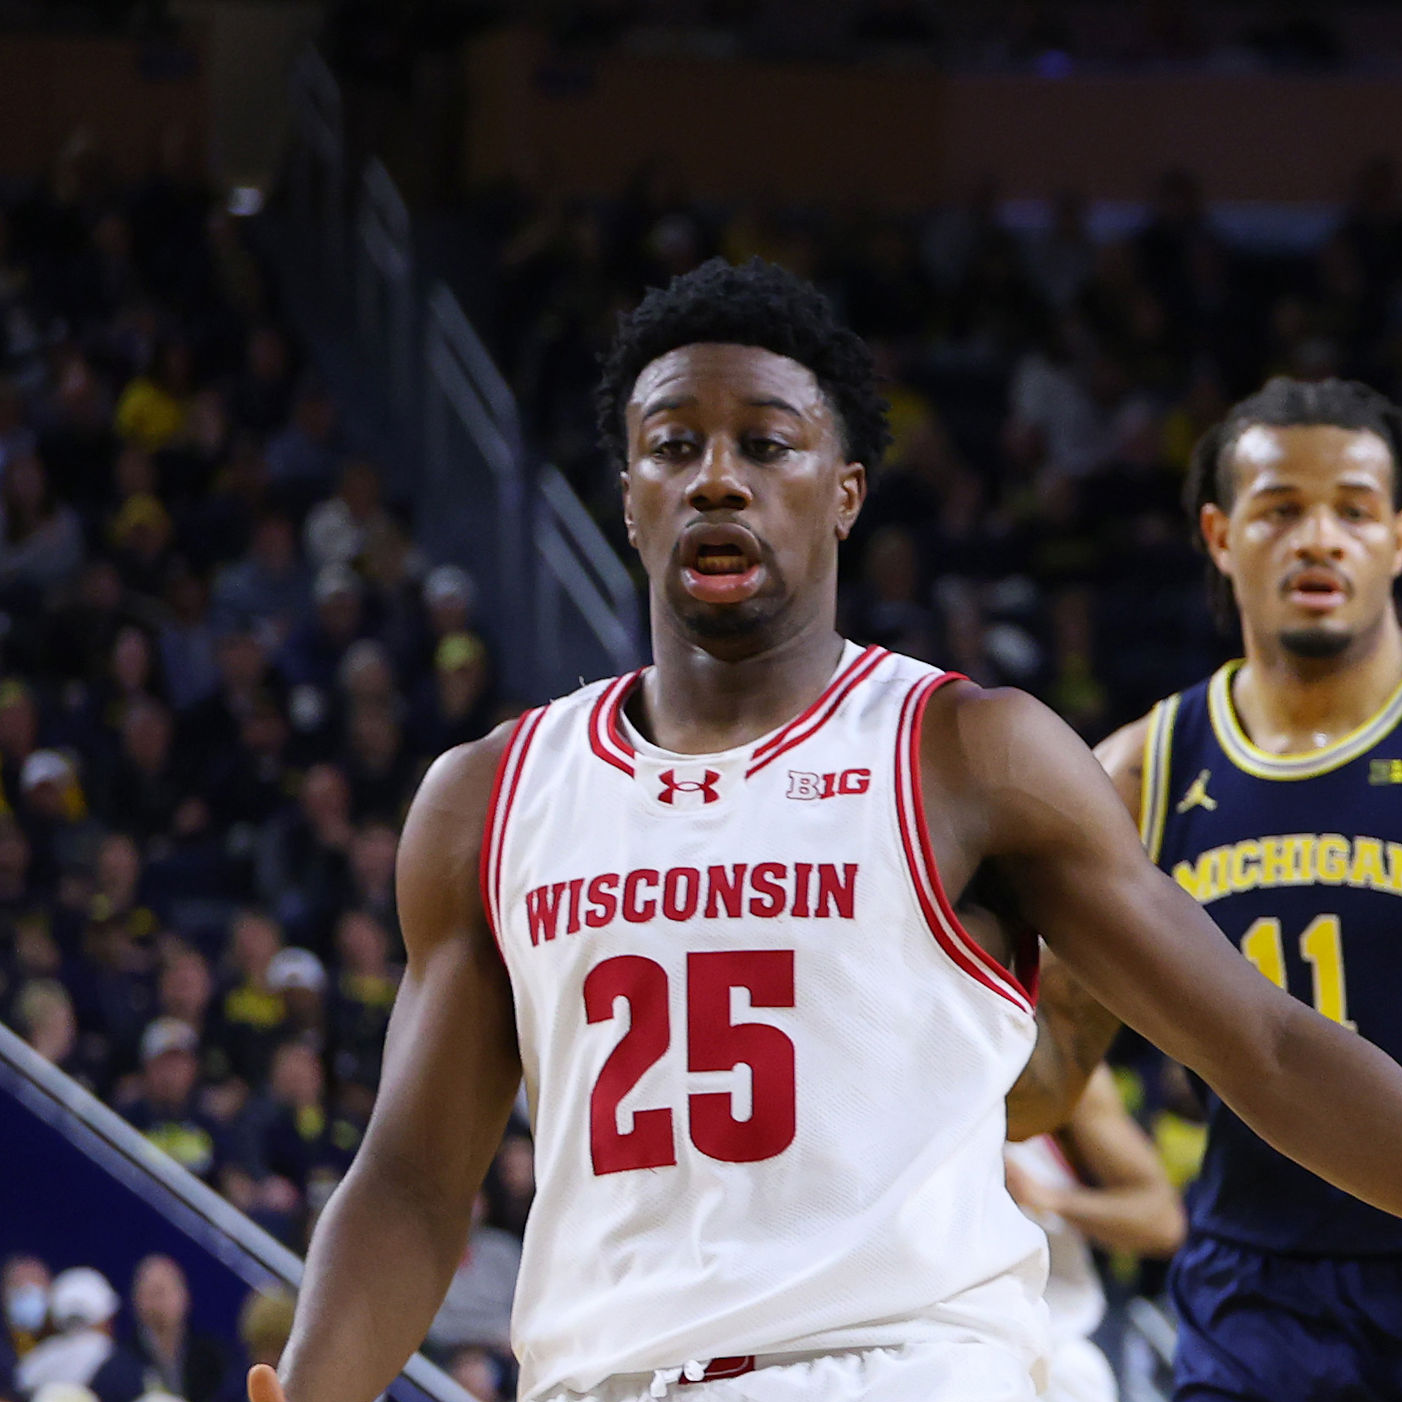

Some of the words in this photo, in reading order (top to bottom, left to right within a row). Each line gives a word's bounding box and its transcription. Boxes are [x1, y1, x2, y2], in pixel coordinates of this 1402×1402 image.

[526, 862, 858, 946] WISCONSIN
[1240, 913, 1358, 1032] 11
[584, 949, 797, 1175] 25
